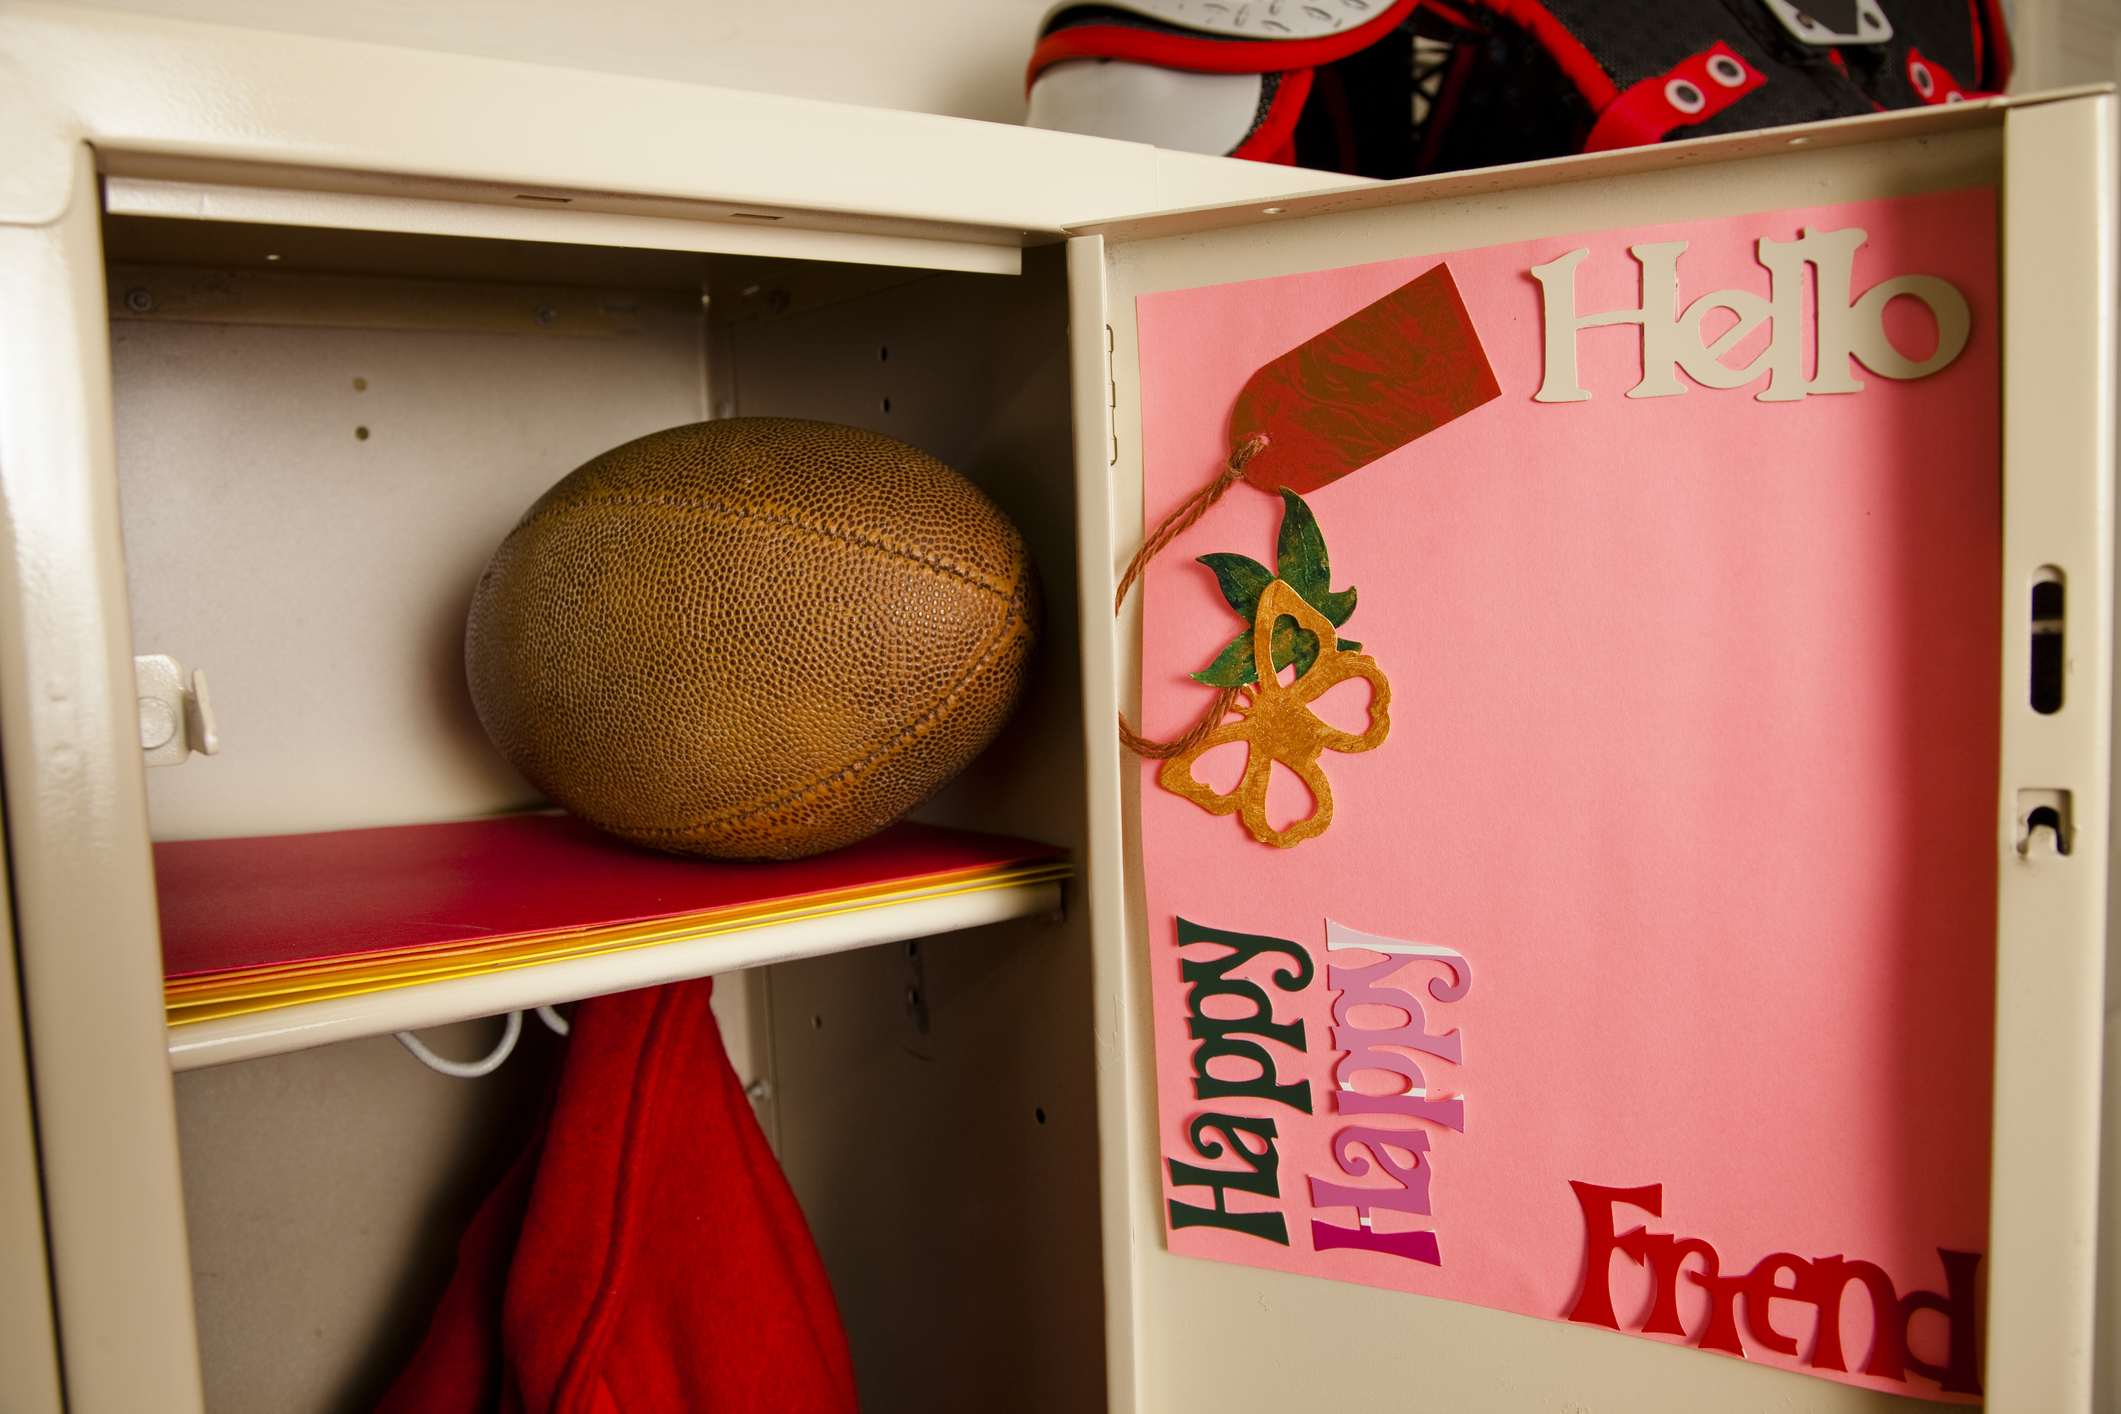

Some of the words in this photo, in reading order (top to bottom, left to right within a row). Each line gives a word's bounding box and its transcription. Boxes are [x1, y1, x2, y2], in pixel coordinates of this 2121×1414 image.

[1531, 225, 1971, 402] Hello
[1168, 915, 1315, 1247] Happy
[1309, 917, 1473, 1267] Happy
[1568, 1179, 1984, 1396] Friend
